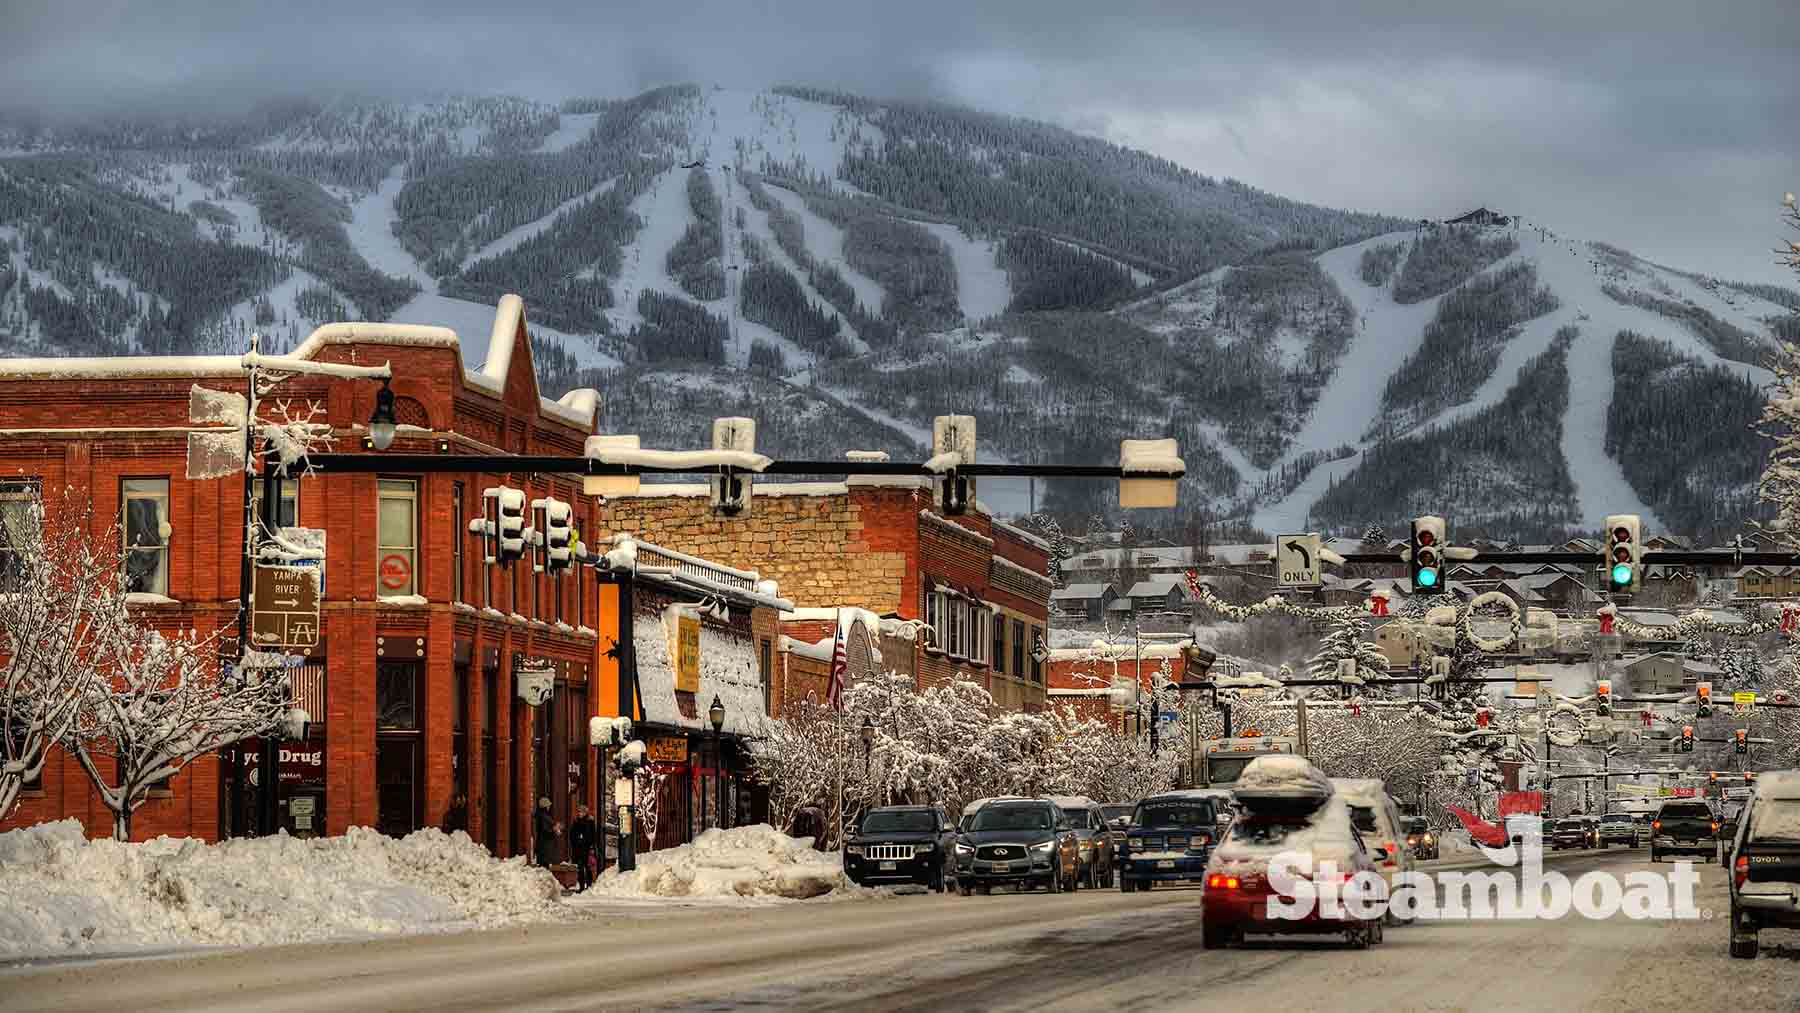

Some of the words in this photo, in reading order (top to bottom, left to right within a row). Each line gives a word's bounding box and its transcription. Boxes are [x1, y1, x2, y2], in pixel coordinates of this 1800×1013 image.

[273, 571, 303, 581] YAMPA
[1284, 571, 1314, 582] ONLY
[275, 584, 300, 594] RIVER
[279, 750, 322, 766] Drug
